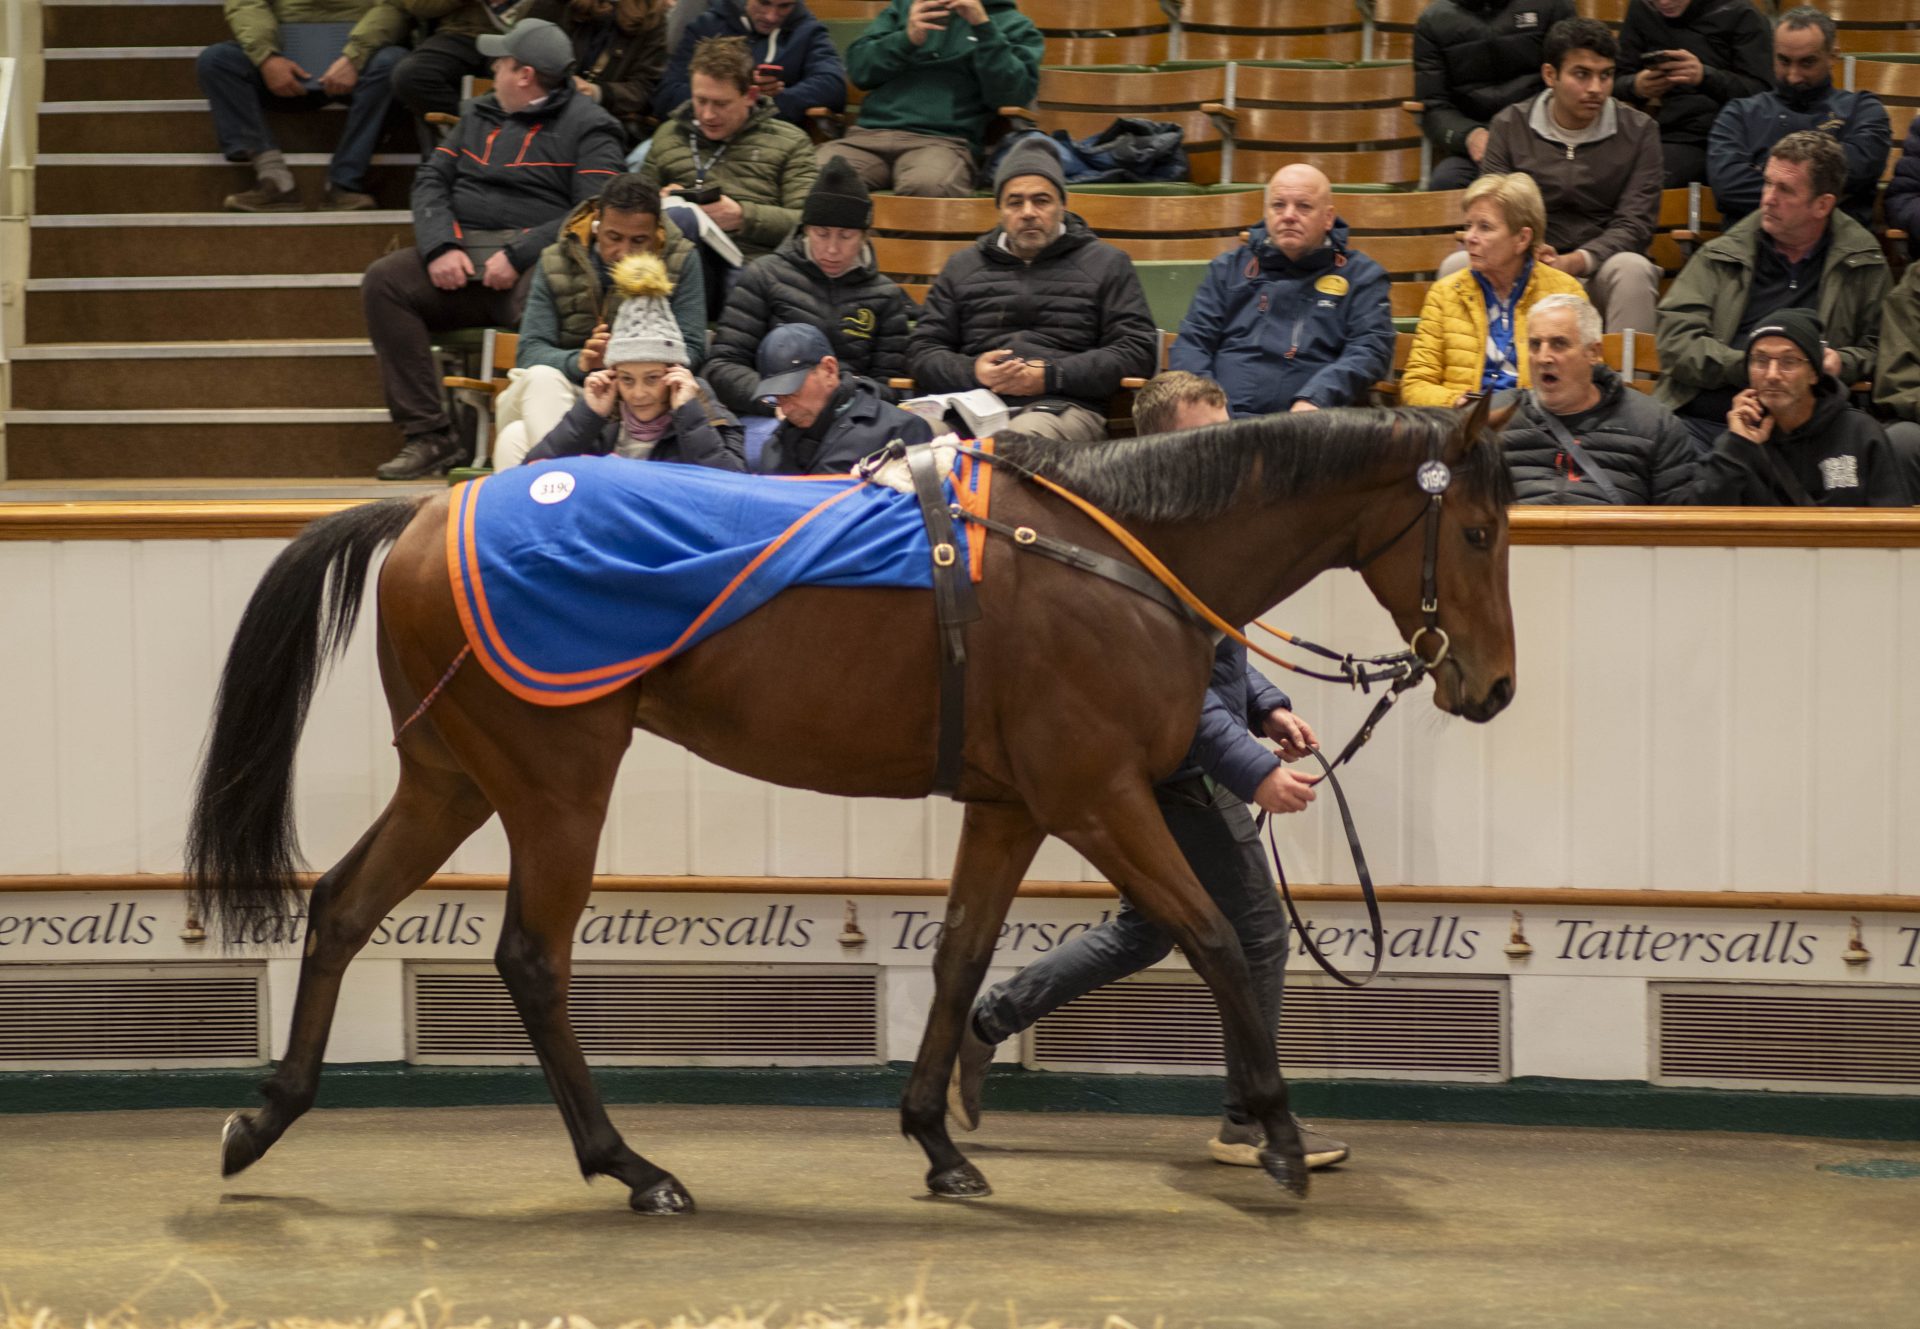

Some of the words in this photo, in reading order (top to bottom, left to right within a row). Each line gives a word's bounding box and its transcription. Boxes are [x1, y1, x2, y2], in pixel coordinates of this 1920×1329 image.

[1421, 470, 1447, 490] 319C
[573, 904, 815, 948] attersalls
[1556, 919, 1819, 965] Tattersalls
